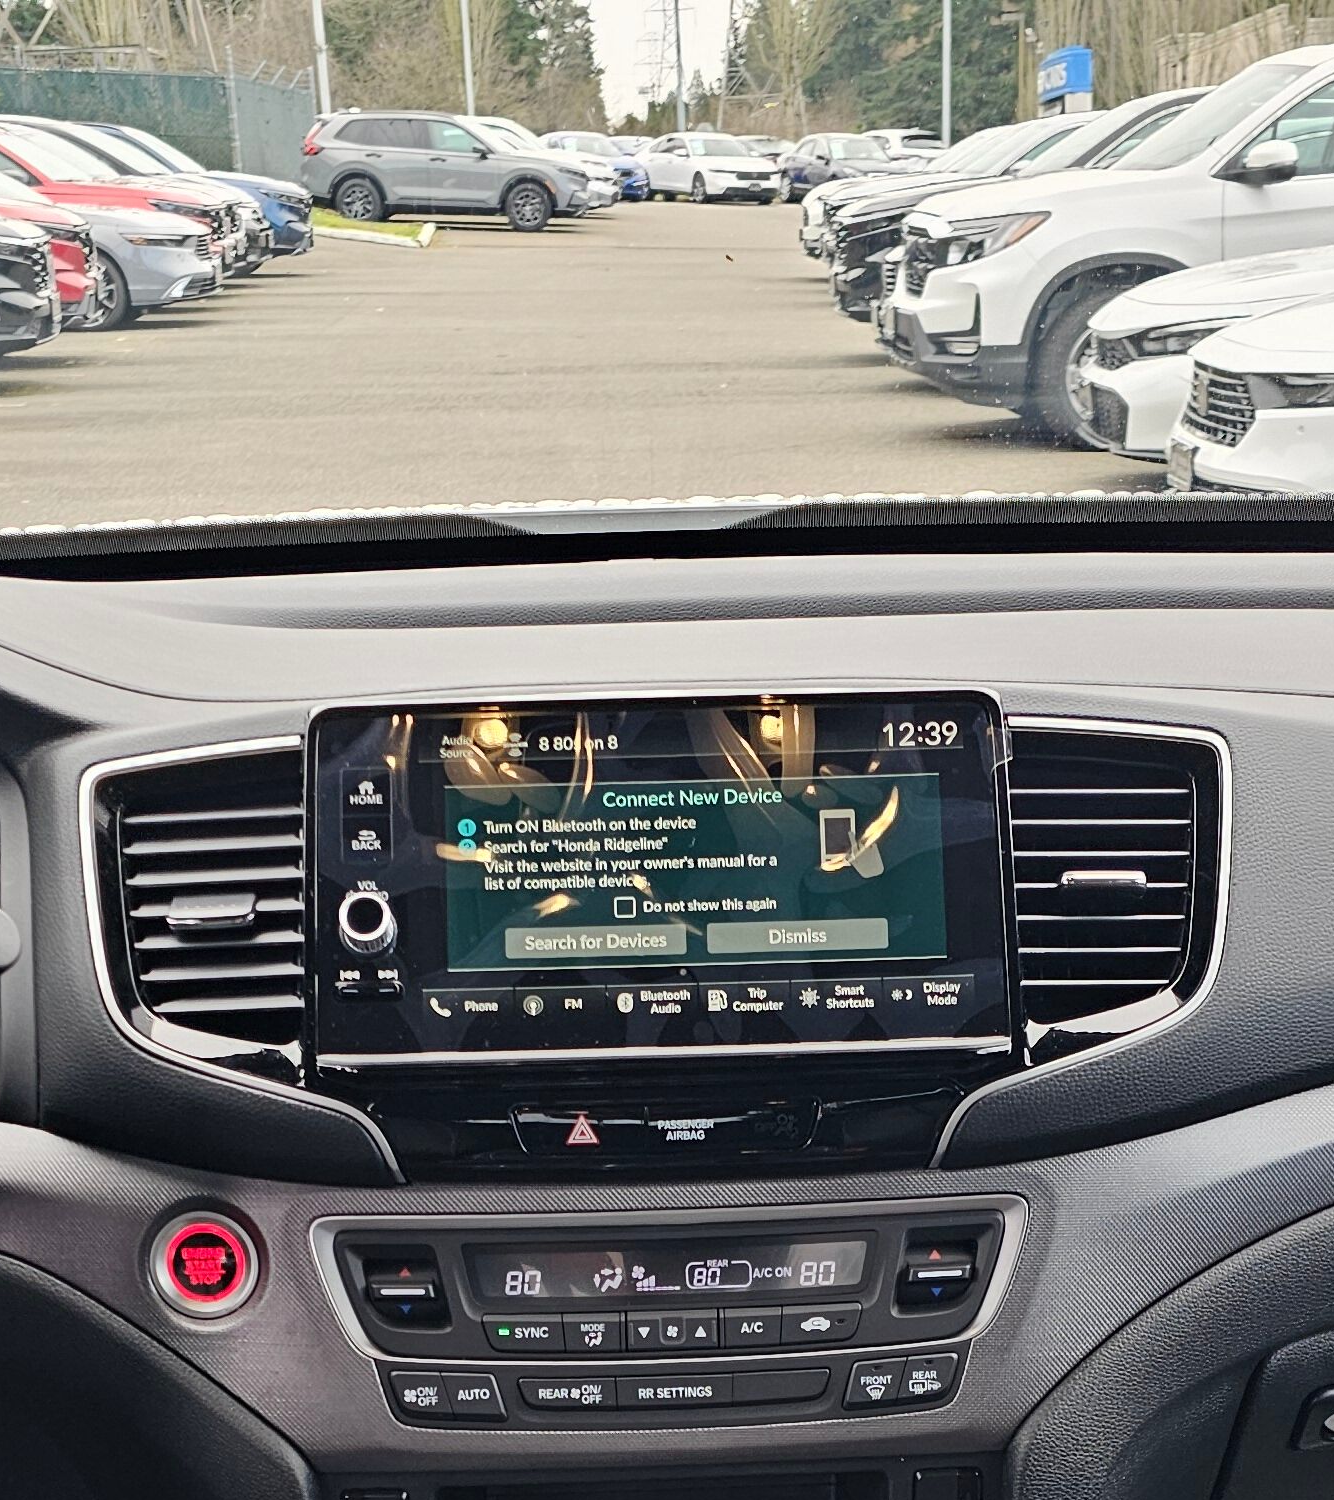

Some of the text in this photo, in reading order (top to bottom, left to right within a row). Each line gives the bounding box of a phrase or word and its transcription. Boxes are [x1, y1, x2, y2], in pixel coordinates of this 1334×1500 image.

[442, 735, 472, 746] Audio
[882, 721, 959, 748] 12:39
[538, 737, 549, 750] 8
[552, 736, 581, 750] 80
[607, 735, 618, 750] 8
[440, 749, 473, 759] Source
[349, 794, 383, 805] HOME
[603, 788, 783, 808] Connect New Device
[483, 816, 697, 834] Turn ON Bluetooth on the device
[351, 840, 382, 851] BACK
[483, 837, 668, 854] Search for "Honda Ridgeline"
[484, 854, 778, 873] Visit the website in your owner's manual for a
[357, 880, 378, 891] VOL
[484, 874, 596, 892] list of compatible
[643, 897, 777, 913] Do not show this again
[524, 932, 668, 951] Search for Devices
[768, 928, 827, 945] Dismiss
[747, 987, 767, 1000] Trip
[834, 985, 865, 997] Smart
[922, 982, 961, 995] Display
[640, 989, 691, 1002] Bluetooth
[927, 994, 958, 1006] Mode
[464, 1000, 498, 1012] Phone
[564, 998, 583, 1010] FM
[650, 1002, 682, 1014] Audio
[732, 1001, 784, 1013] Computer
[826, 997, 875, 1010] Shortcuts
[657, 1118, 714, 1130] PASSENGER
[666, 1130, 705, 1141] AIRBAG
[706, 1259, 728, 1268] REAR
[692, 1267, 720, 1286] 80
[753, 1266, 792, 1279] A/C ON
[799, 1261, 835, 1287] 80
[504, 1270, 541, 1296] 80
[514, 1327, 549, 1339] SYNC
[580, 1323, 605, 1332] MODE
[740, 1322, 764, 1334] A/C
[860, 1375, 892, 1386] FRONT
[912, 1370, 937, 1380] REAR
[417, 1386, 437, 1397] ON/
[457, 1388, 490, 1401] AUTO
[538, 1384, 601, 1400] REAR ON/
[638, 1385, 713, 1400] RR SETTINGS
[417, 1396, 438, 1407] OFF
[581, 1394, 602, 1405] OFF
